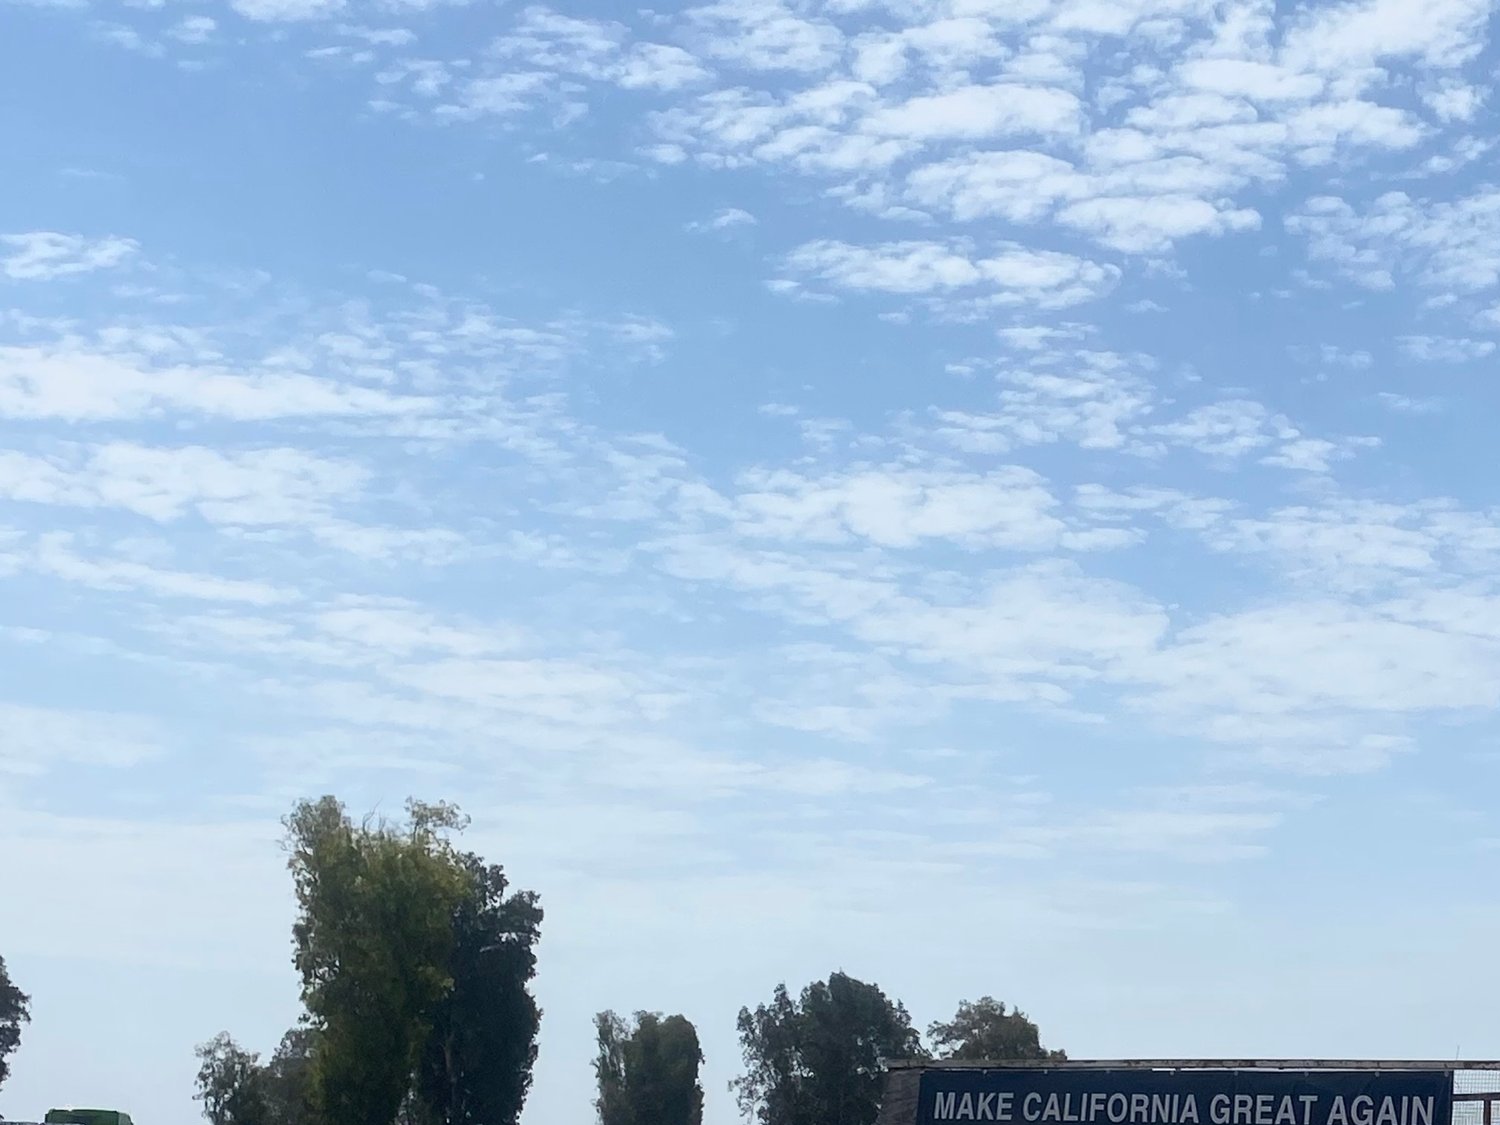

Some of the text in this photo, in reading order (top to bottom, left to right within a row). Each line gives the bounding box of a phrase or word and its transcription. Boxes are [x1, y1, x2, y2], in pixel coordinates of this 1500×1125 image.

[934, 1092, 1014, 1121] MAKE
[1023, 1093, 1199, 1124] CALIFORNIA
[1209, 1093, 1318, 1125] GREAT
